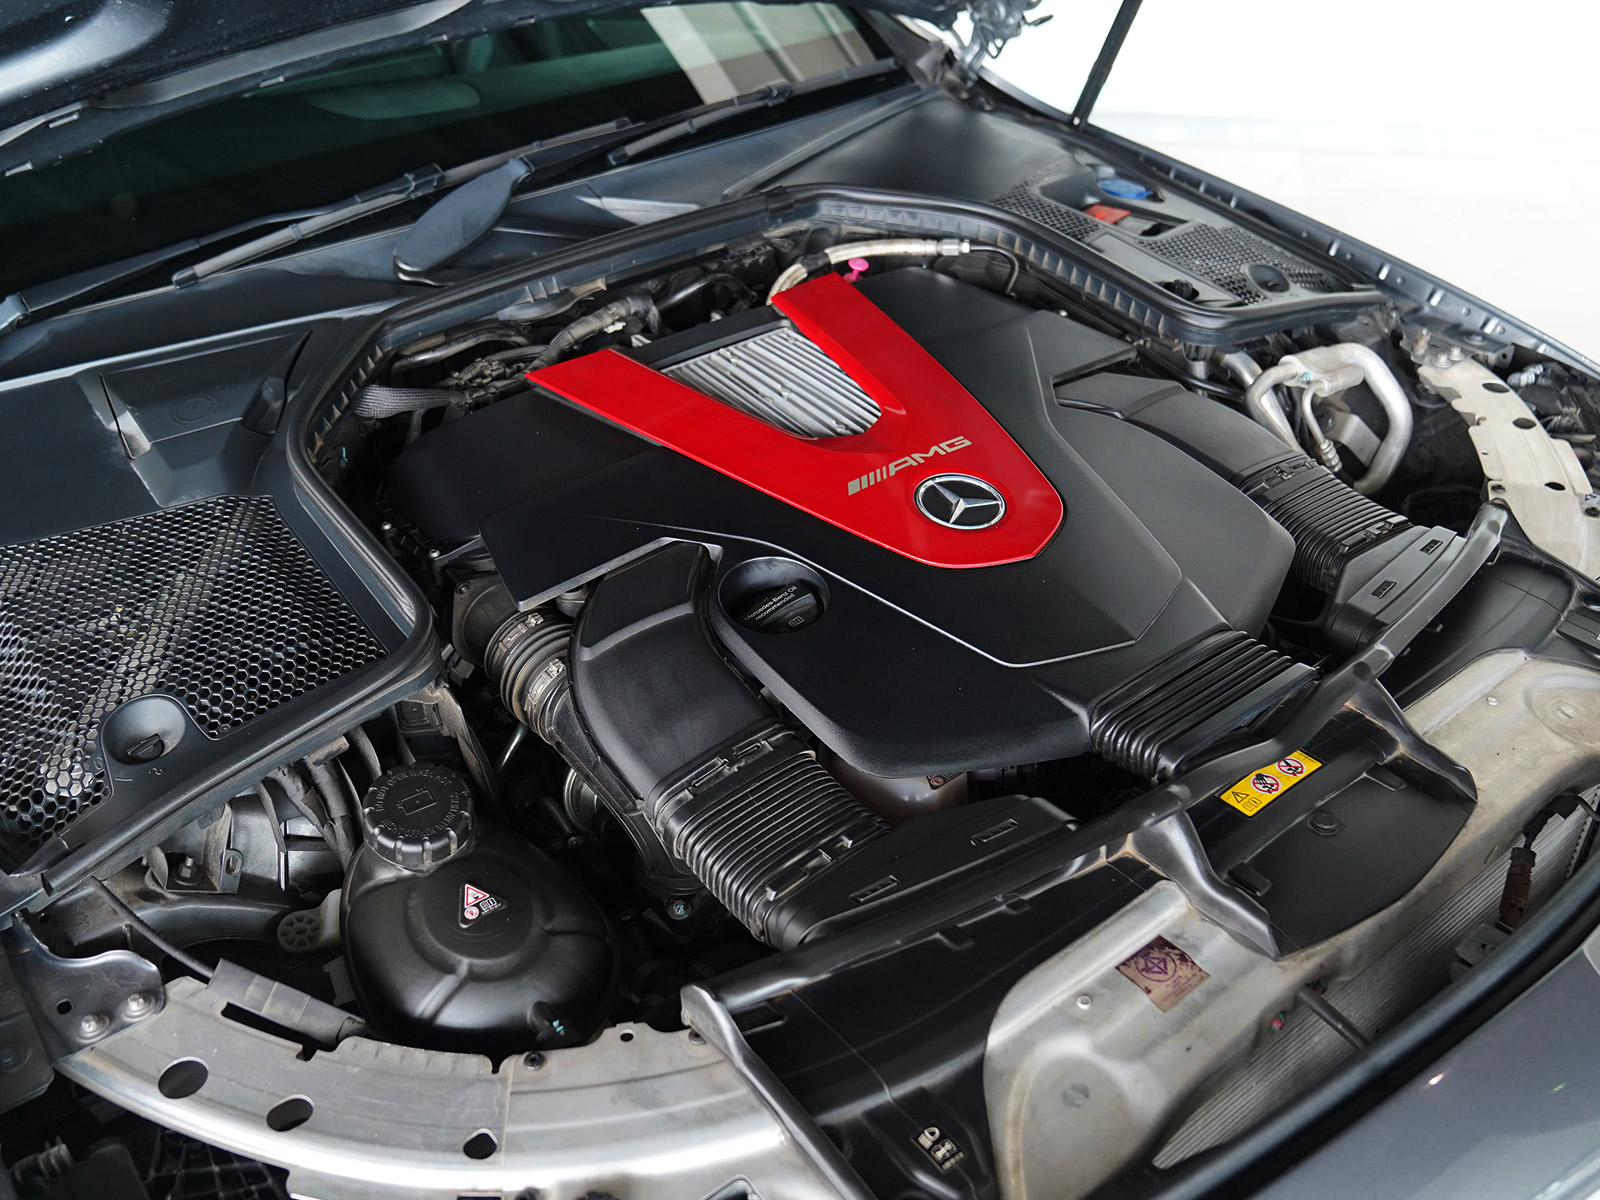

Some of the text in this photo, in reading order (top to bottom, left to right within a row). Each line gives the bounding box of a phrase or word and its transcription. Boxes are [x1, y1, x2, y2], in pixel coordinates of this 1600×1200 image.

[888, 435, 972, 477] AMG
[744, 591, 789, 621] Mercedes-Benz
[755, 593, 796, 621] recommended
[386, 770, 408, 787] OPEN
